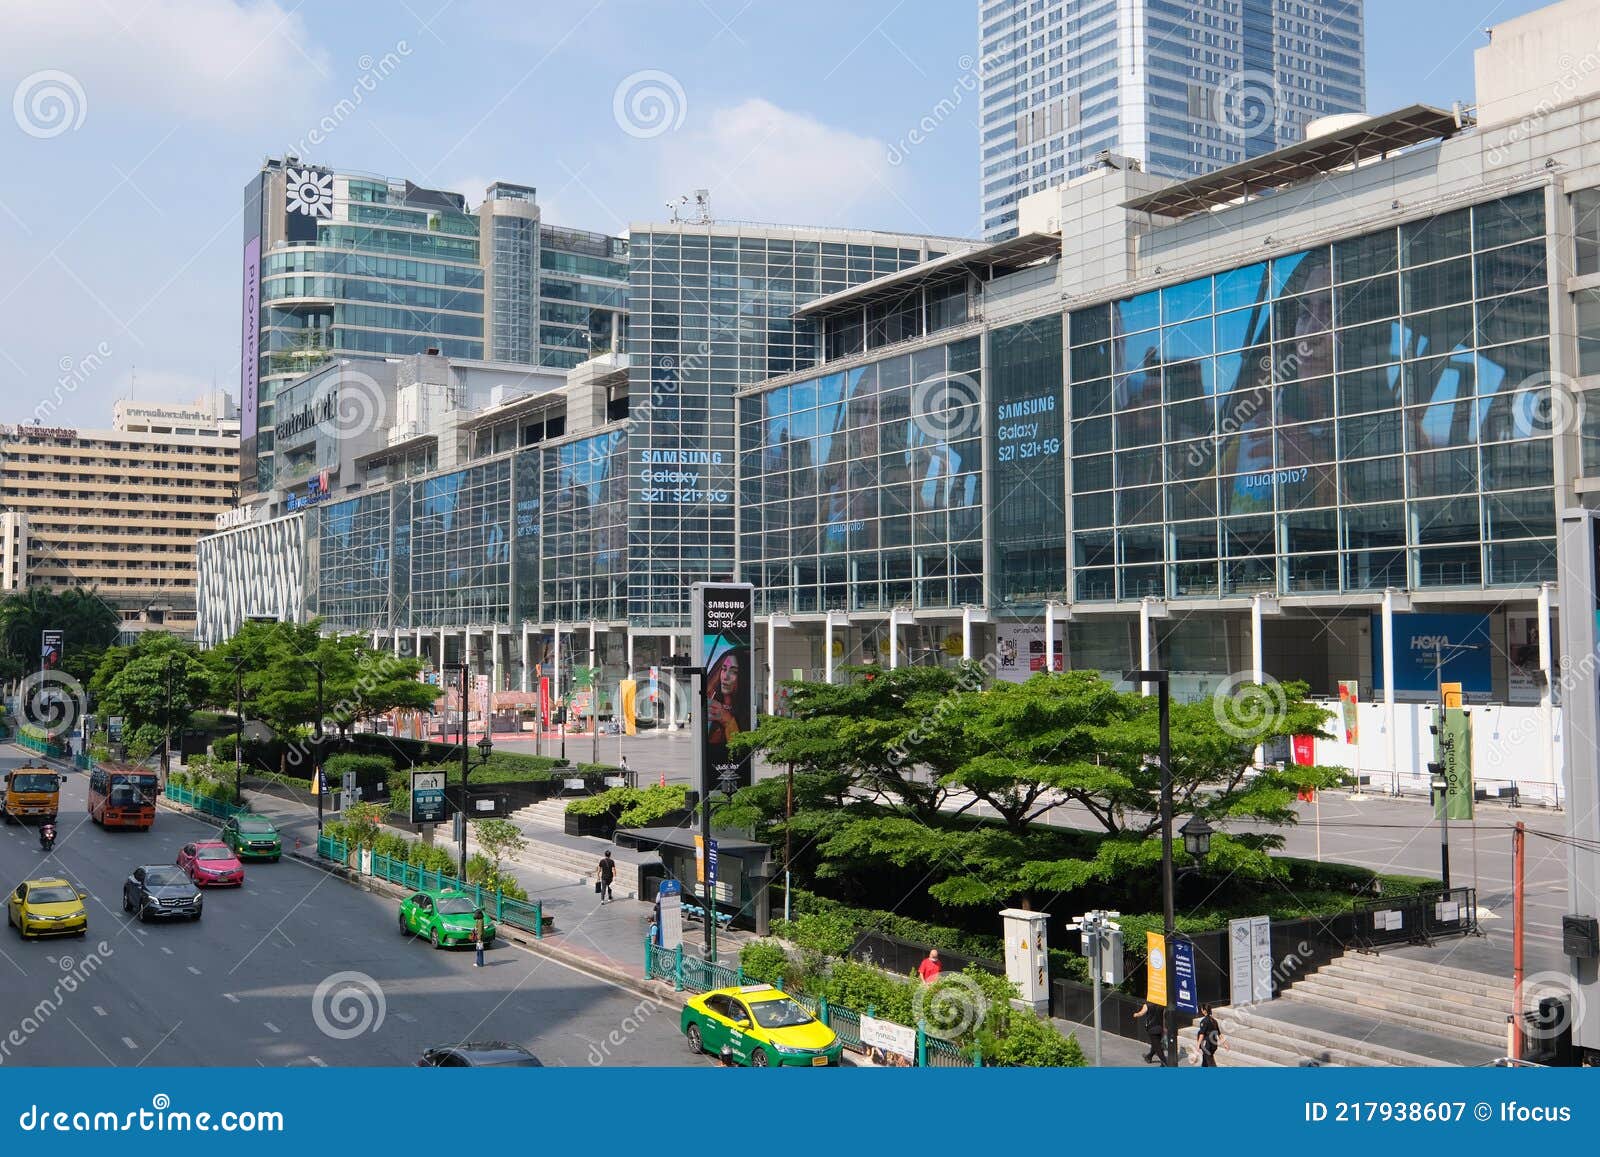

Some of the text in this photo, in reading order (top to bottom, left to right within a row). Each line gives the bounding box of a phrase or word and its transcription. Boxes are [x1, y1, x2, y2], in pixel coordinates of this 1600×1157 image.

[998, 396, 1055, 420] SAMSUNG
[998, 423, 1038, 440] Galaxy
[998, 445, 1015, 461] S21
[1043, 438, 1060, 454] 5G
[641, 450, 722, 465] SAMSUNG
[641, 469, 699, 486] Galaxy
[641, 488, 664, 501] S21
[706, 489, 728, 502] 5G
[708, 601, 745, 609] SAMSUNG
[708, 611, 735, 620] Galaxy
[708, 620, 719, 628] S21
[1410, 636, 1449, 650] HOKA
